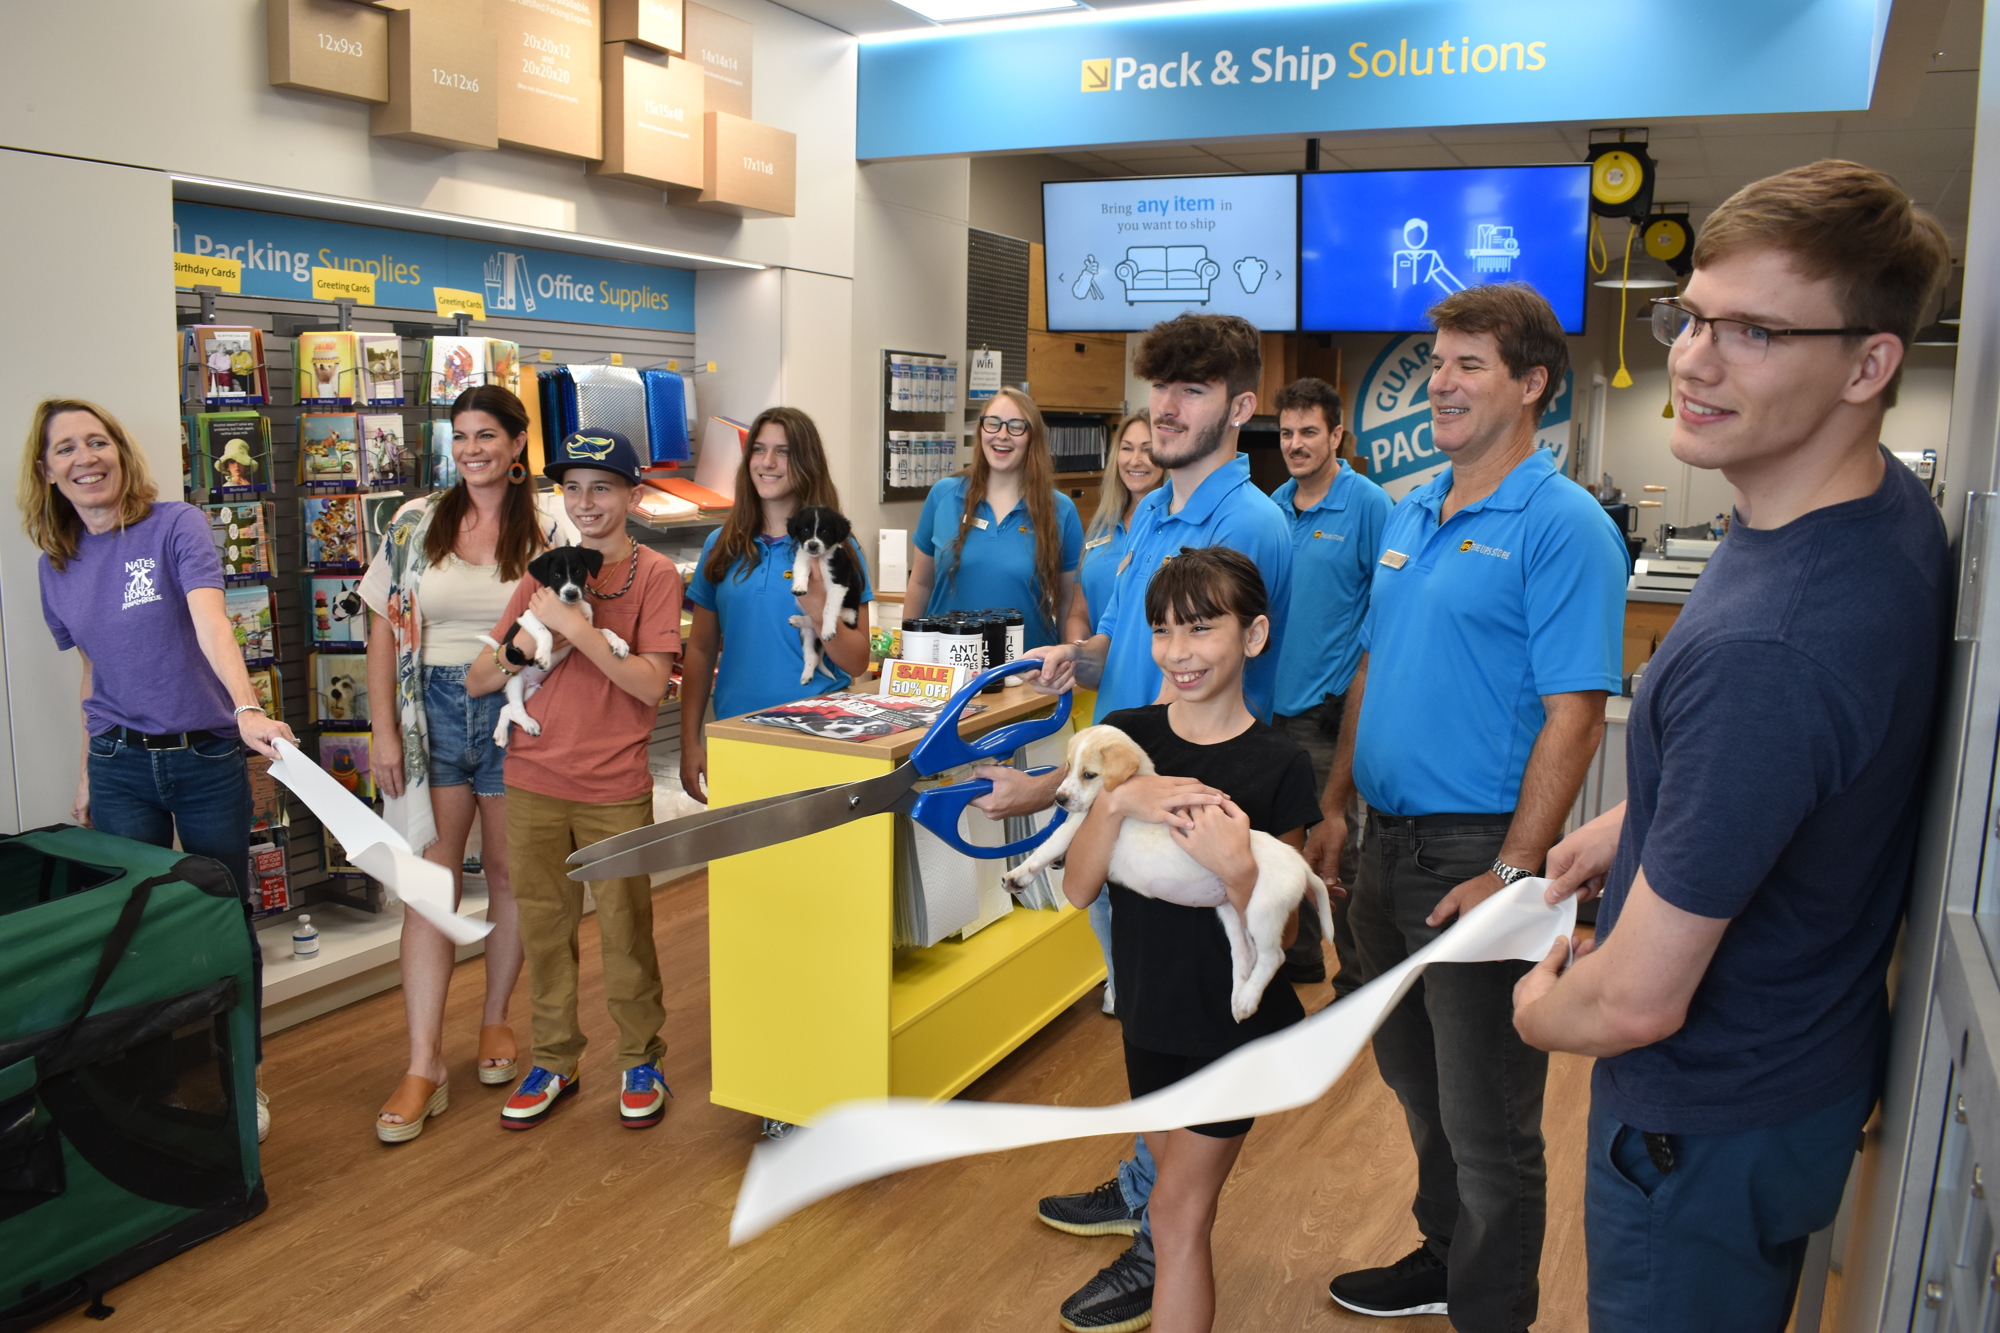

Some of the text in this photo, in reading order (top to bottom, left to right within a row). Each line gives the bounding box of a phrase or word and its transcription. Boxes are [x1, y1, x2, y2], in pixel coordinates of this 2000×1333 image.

[318, 33, 363, 57] 12x9x3
[523, 32, 571, 59] 20x20x12
[701, 48, 738, 72] 14x14x14
[1114, 36, 1547, 91] Pack & Ship Solutions
[432, 68, 479, 93] 12x12x6
[522, 58, 570, 84] 20x20x20
[643, 99, 684, 122] 15x15x48
[742, 156, 774, 176] 17x11x8
[1101, 195, 1232, 217] Bring any item in
[1117, 218, 1216, 234] you want to ship
[194, 234, 421, 285] Packing Supplies
[173, 262, 236, 279] Birthday Cards
[317, 279, 370, 293] Greeting Cards
[537, 273, 669, 313] Office Supplies
[438, 296, 482, 310] Greeting Cards
[976, 358, 993, 369] Wifi
[1371, 420, 1441, 474] PAC
[1479, 544, 1493, 555] UPS
[1491, 547, 1511, 560] STORE
[125, 558, 156, 573] NATE'S
[124, 587, 155, 603] HONOR
[949, 644, 978, 654] ANTI
[949, 653, 978, 663] -BAC
[896, 664, 948, 683] SALE
[949, 662, 979, 671] PES
[891, 679, 950, 699] 50% OFF
